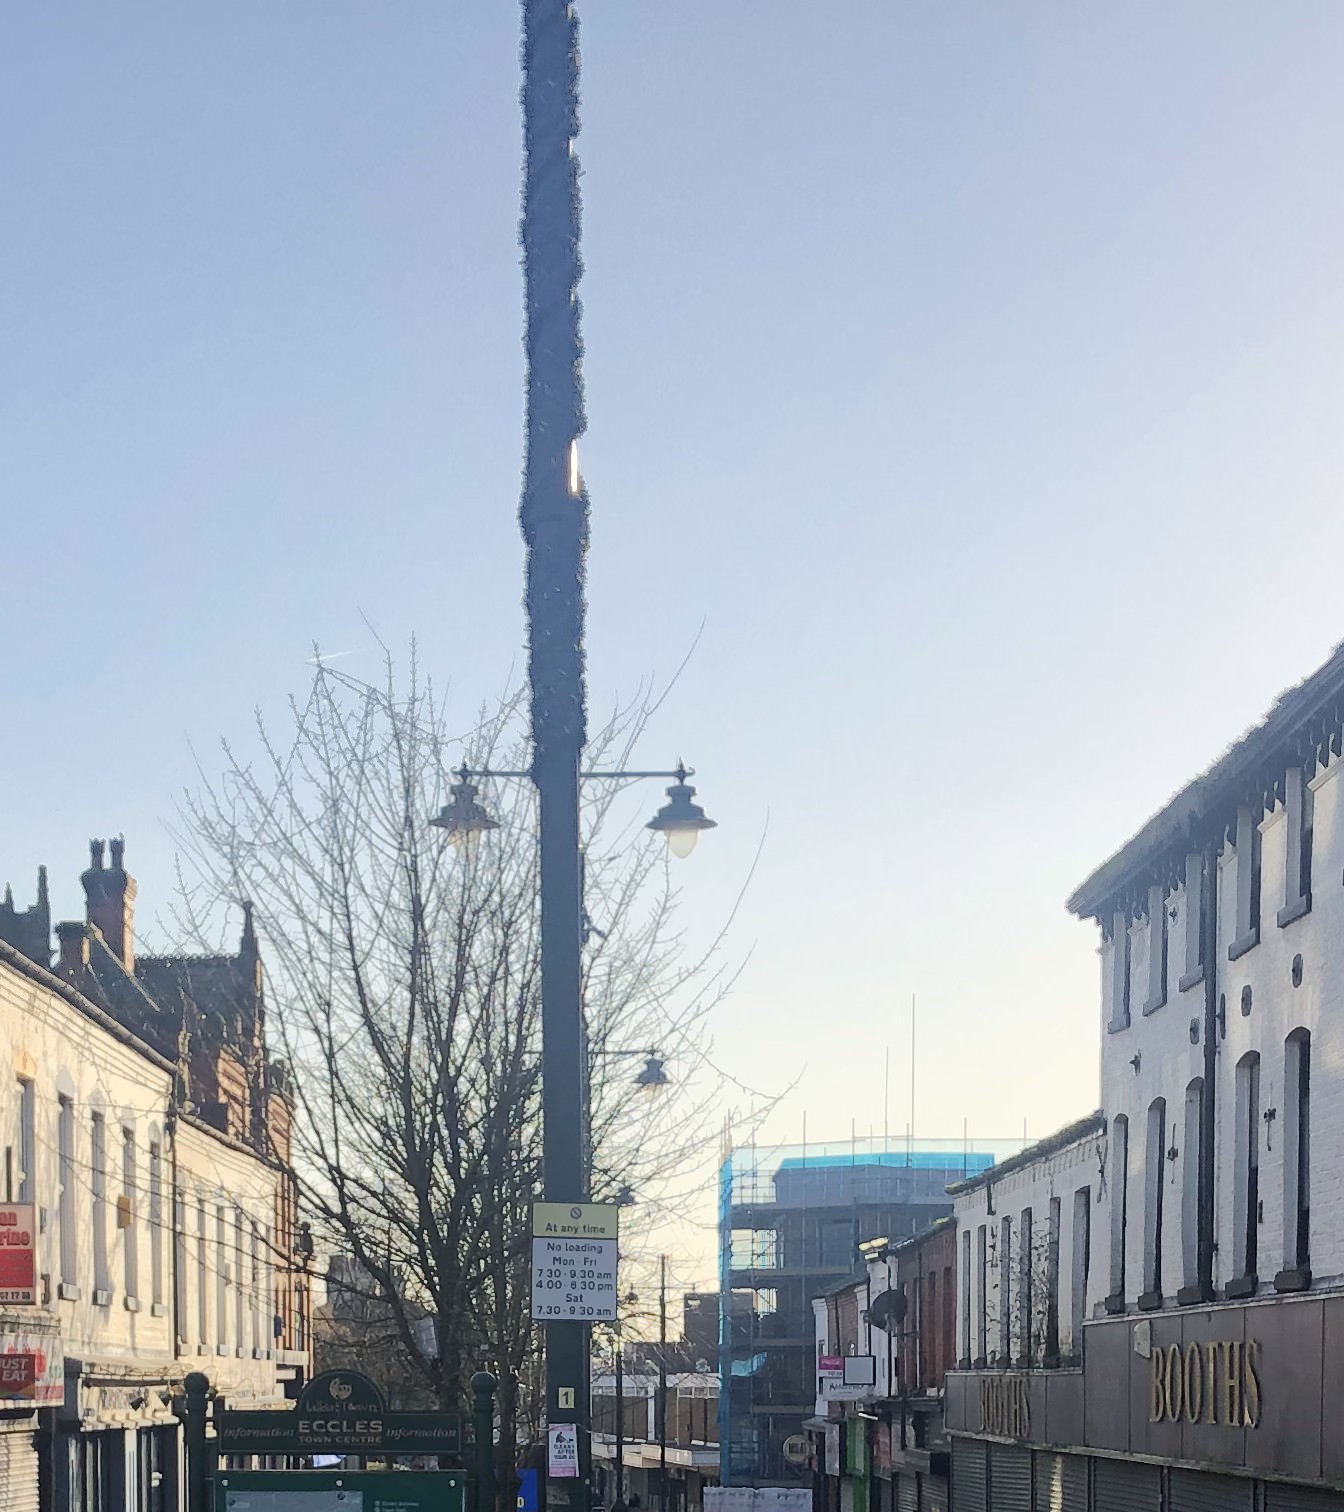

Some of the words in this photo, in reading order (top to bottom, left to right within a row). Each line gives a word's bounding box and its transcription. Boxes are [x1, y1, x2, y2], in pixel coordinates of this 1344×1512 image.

[545, 1222, 558, 1232] At
[561, 1225, 578, 1235] any
[583, 1224, 606, 1233] time
[547, 1242, 561, 1251] No
[566, 1243, 603, 1254] loading
[552, 1257, 575, 1266] Mon
[583, 1257, 597, 1266] Fri
[566, 1293, 584, 1303] Sat
[2, 1370, 29, 1381] EAT
[1149, 1339, 1262, 1429] BOOTHS
[561, 1391, 569, 1405] 1
[979, 1374, 1030, 1438] BOOTHS
[298, 1420, 383, 1433] ECCLES
[299, 1436, 333, 1444] TOWN
[336, 1436, 383, 1444] CENTRE
